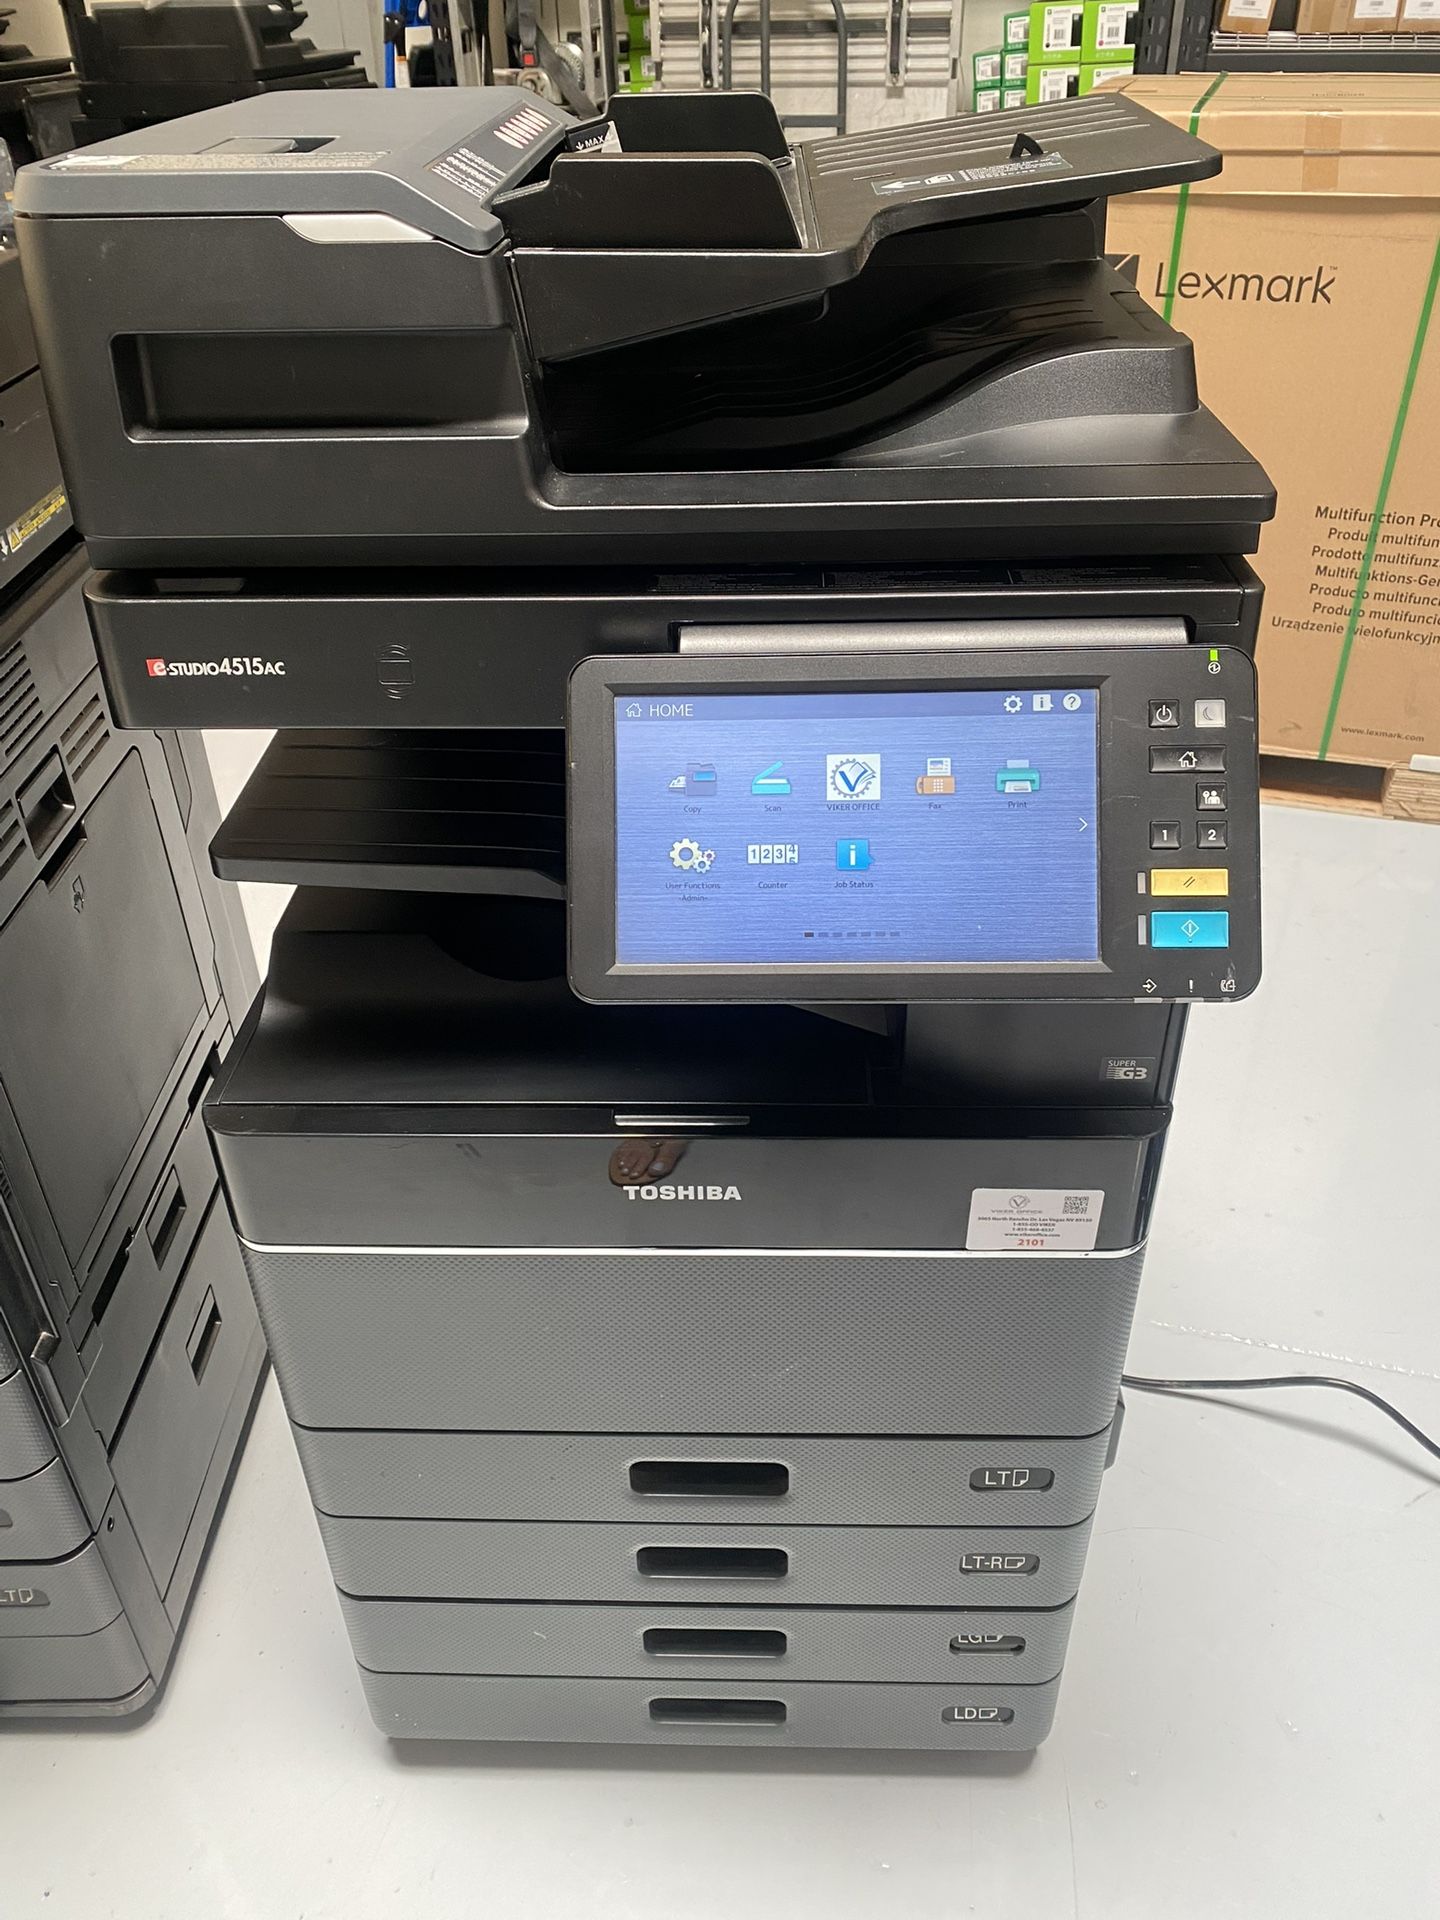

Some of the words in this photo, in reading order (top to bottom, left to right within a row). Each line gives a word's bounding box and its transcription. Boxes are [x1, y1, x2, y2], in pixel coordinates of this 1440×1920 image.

[584, 135, 604, 149] MAX
[1374, 551, 1440, 568] multifunz
[1309, 583, 1370, 599] Produco
[1312, 602, 1365, 618] Produo
[1272, 616, 1344, 635] Urządzenie
[649, 704, 694, 717] HOME
[1341, 726, 1424, 742] www.lexmark.com
[683, 805, 702, 815] Copy
[764, 805, 782, 813] Scan
[826, 803, 850, 811] VIKER
[852, 803, 880, 811] OFFICE
[928, 802, 942, 810] Fax
[1008, 801, 1028, 809] Print
[1162, 829, 1169, 841] 1
[1207, 829, 1216, 841] 2
[684, 881, 720, 889] Functions
[758, 881, 788, 889] Counter
[834, 881, 848, 889] Job
[849, 881, 873, 889] Status
[1121, 1067, 1148, 1080] G3
[623, 1185, 742, 1200] TOSHIBA
[985, 1470, 1011, 1485] LT
[962, 1556, 1002, 1569] LT-R
[954, 1707, 977, 1719] LD
